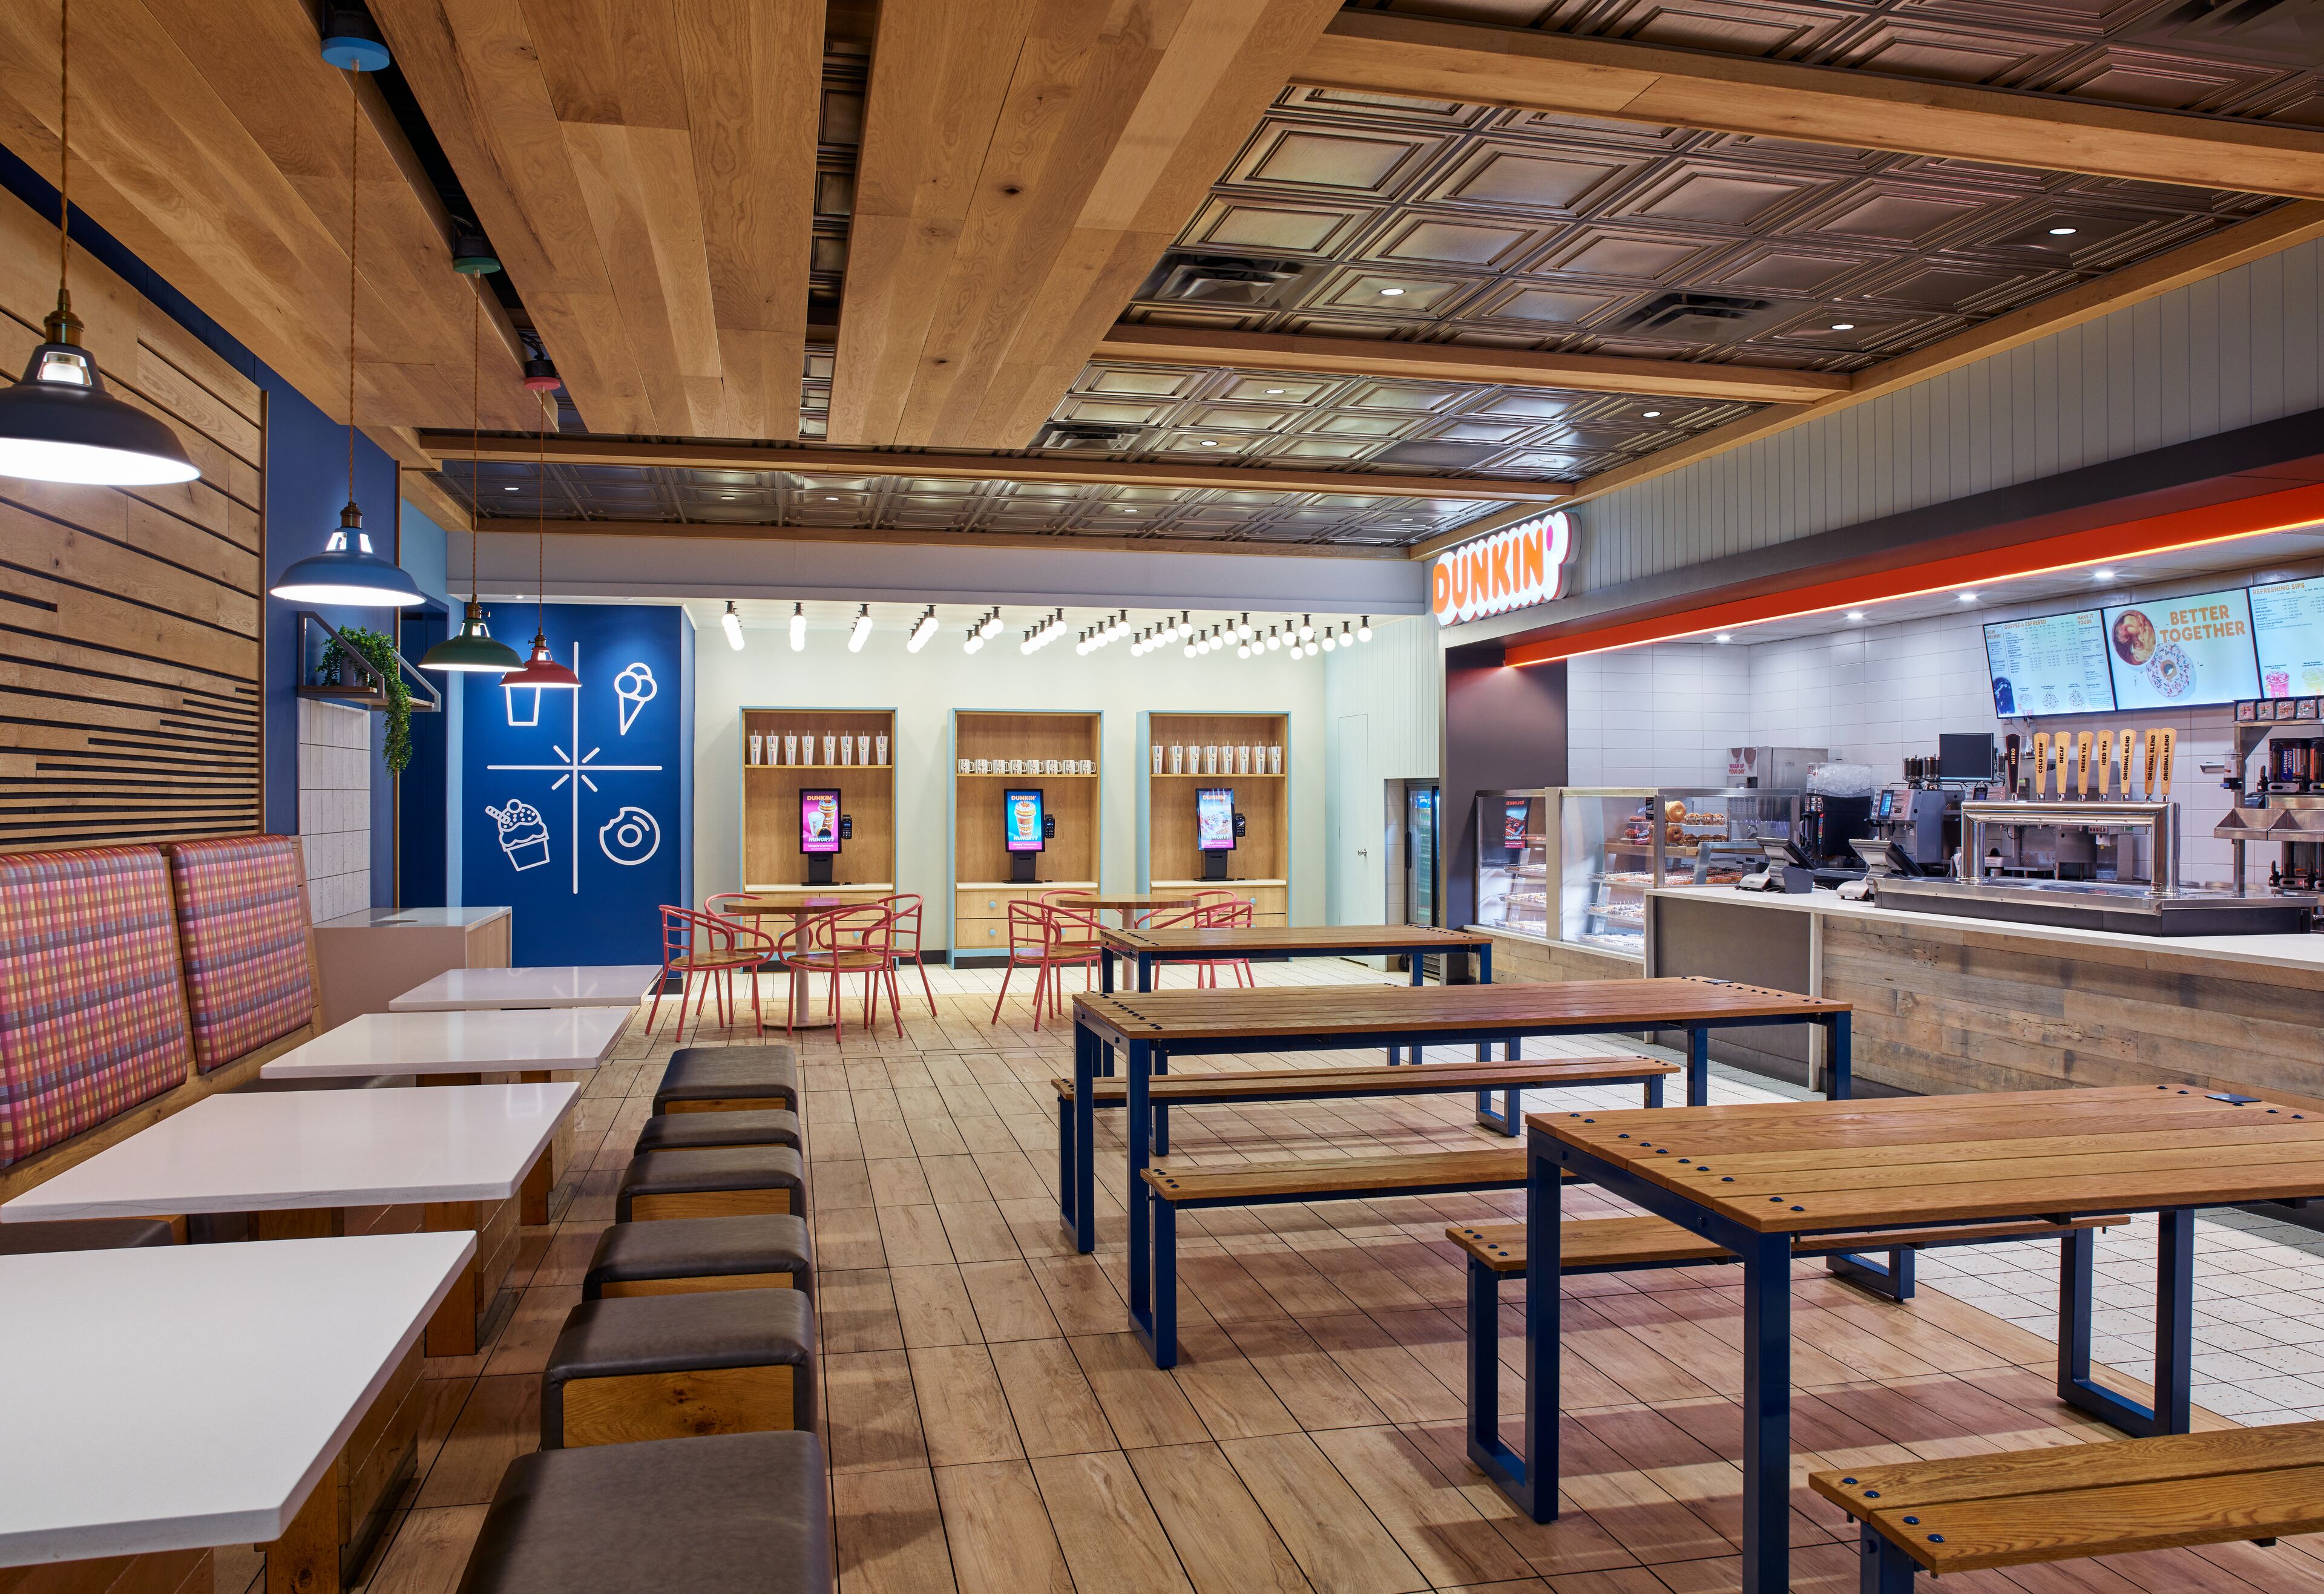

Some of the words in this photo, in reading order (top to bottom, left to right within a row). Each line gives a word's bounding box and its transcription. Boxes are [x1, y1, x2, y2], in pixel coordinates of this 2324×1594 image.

[1433, 524, 1554, 615] DUNKIN'
[2253, 585, 2290, 595] REFRESHING
[2170, 605, 2230, 626] BETTER
[2159, 620, 2245, 643] TOGETHER
